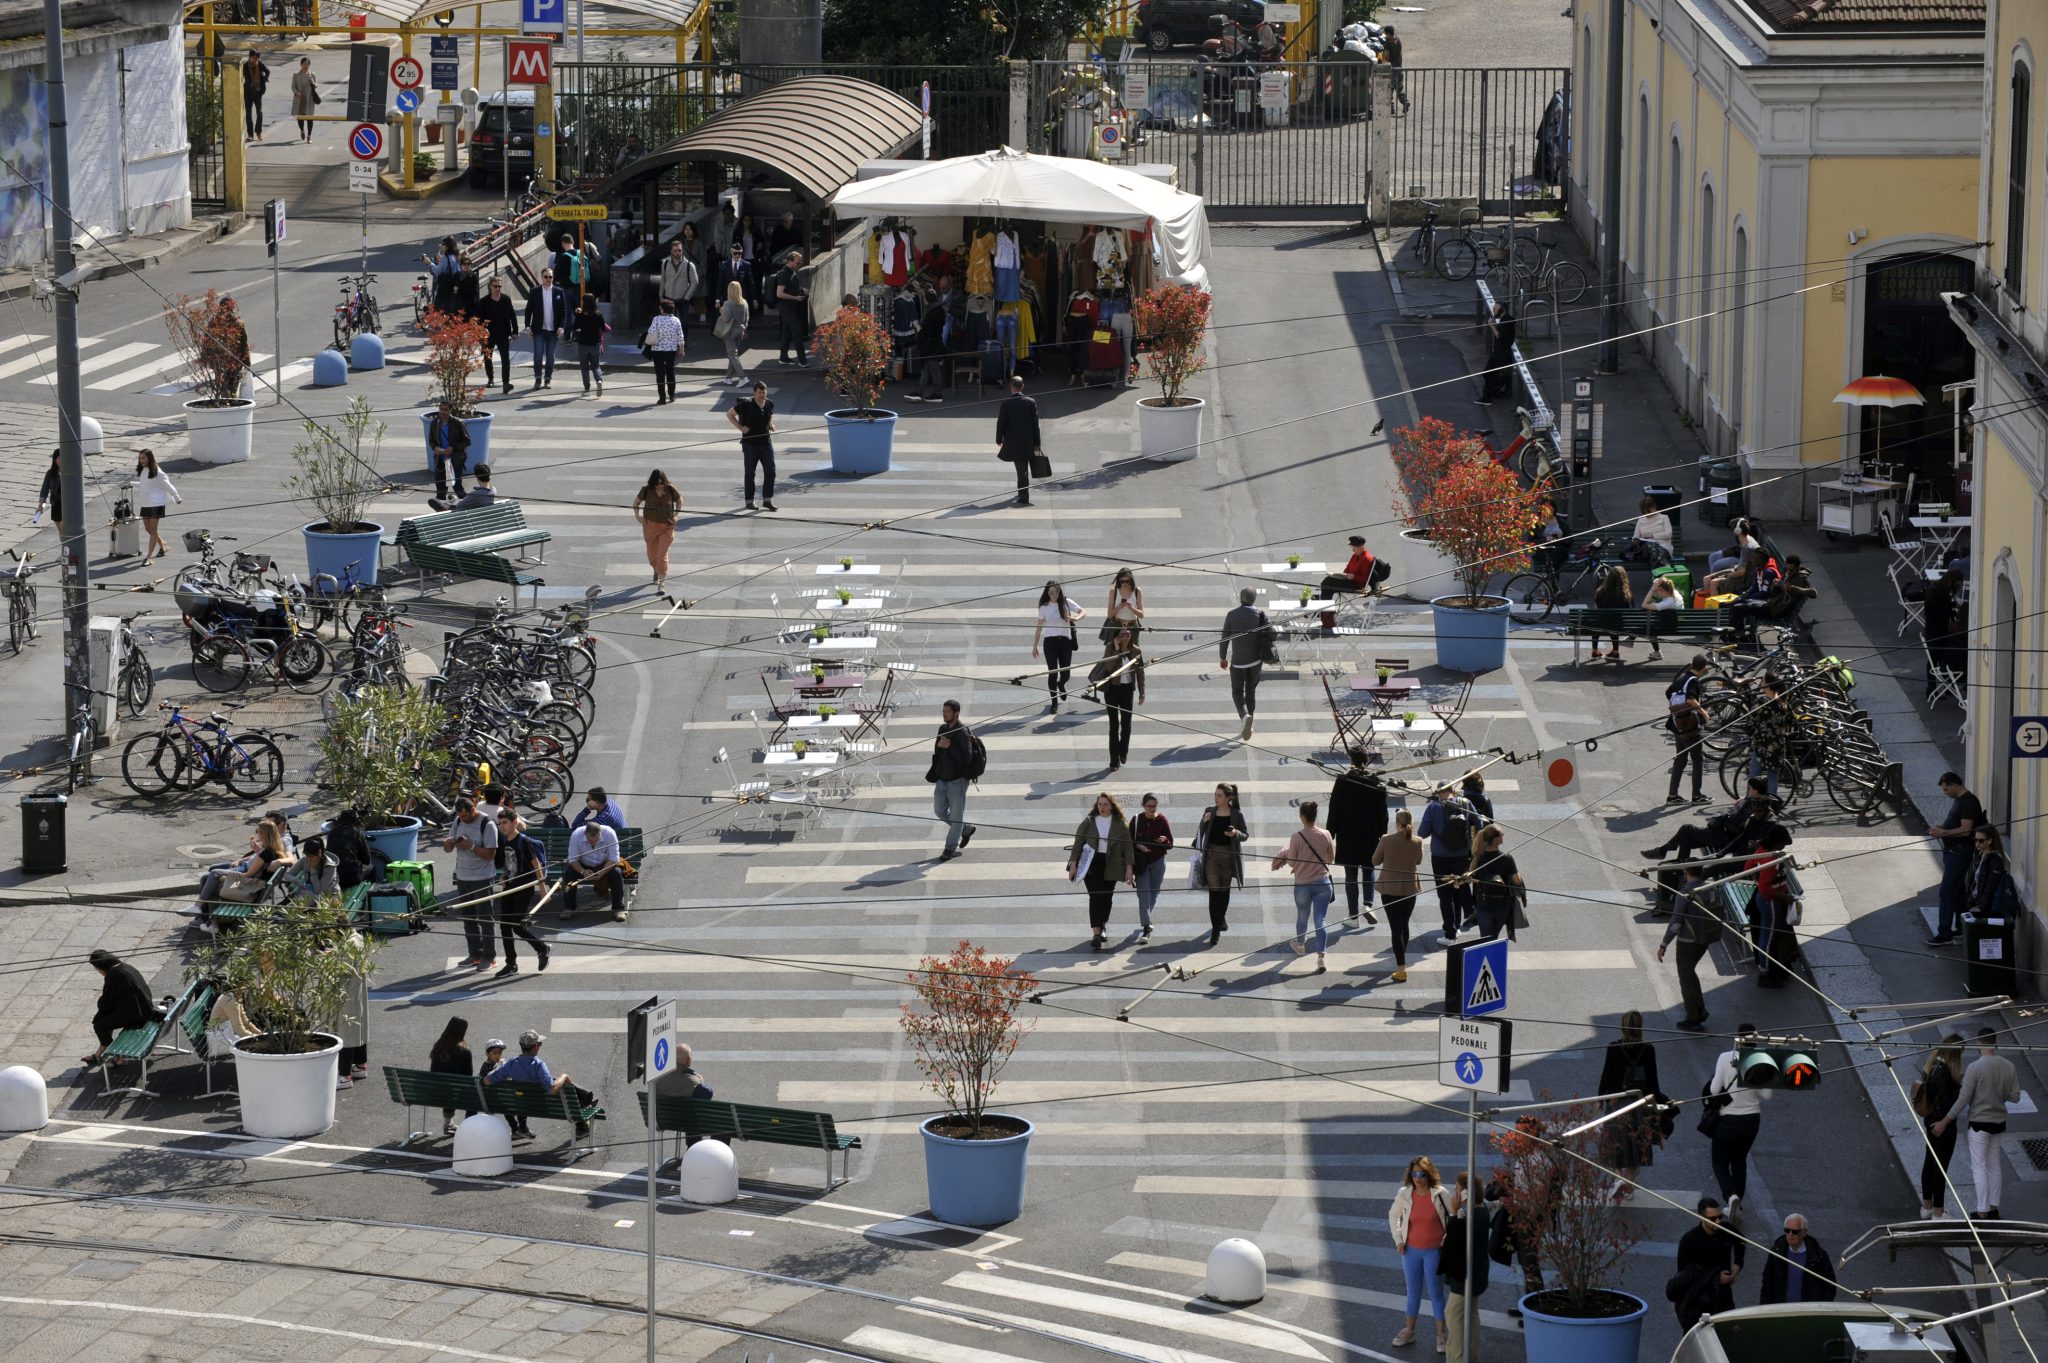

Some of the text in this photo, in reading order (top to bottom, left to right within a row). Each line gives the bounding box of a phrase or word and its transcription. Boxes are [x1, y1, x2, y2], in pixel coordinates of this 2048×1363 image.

[534, 0, 555, 19] P
[512, 50, 547, 76] M
[553, 208, 604, 217] FERMATA TRAM 2
[1880, 290, 1942, 301] COPYBOO
[657, 1009, 667, 1020] AREA
[652, 1020, 671, 1037] PEDONALE
[1460, 1023, 1479, 1035] AREA
[1451, 1035, 1488, 1050] PEDONALE
